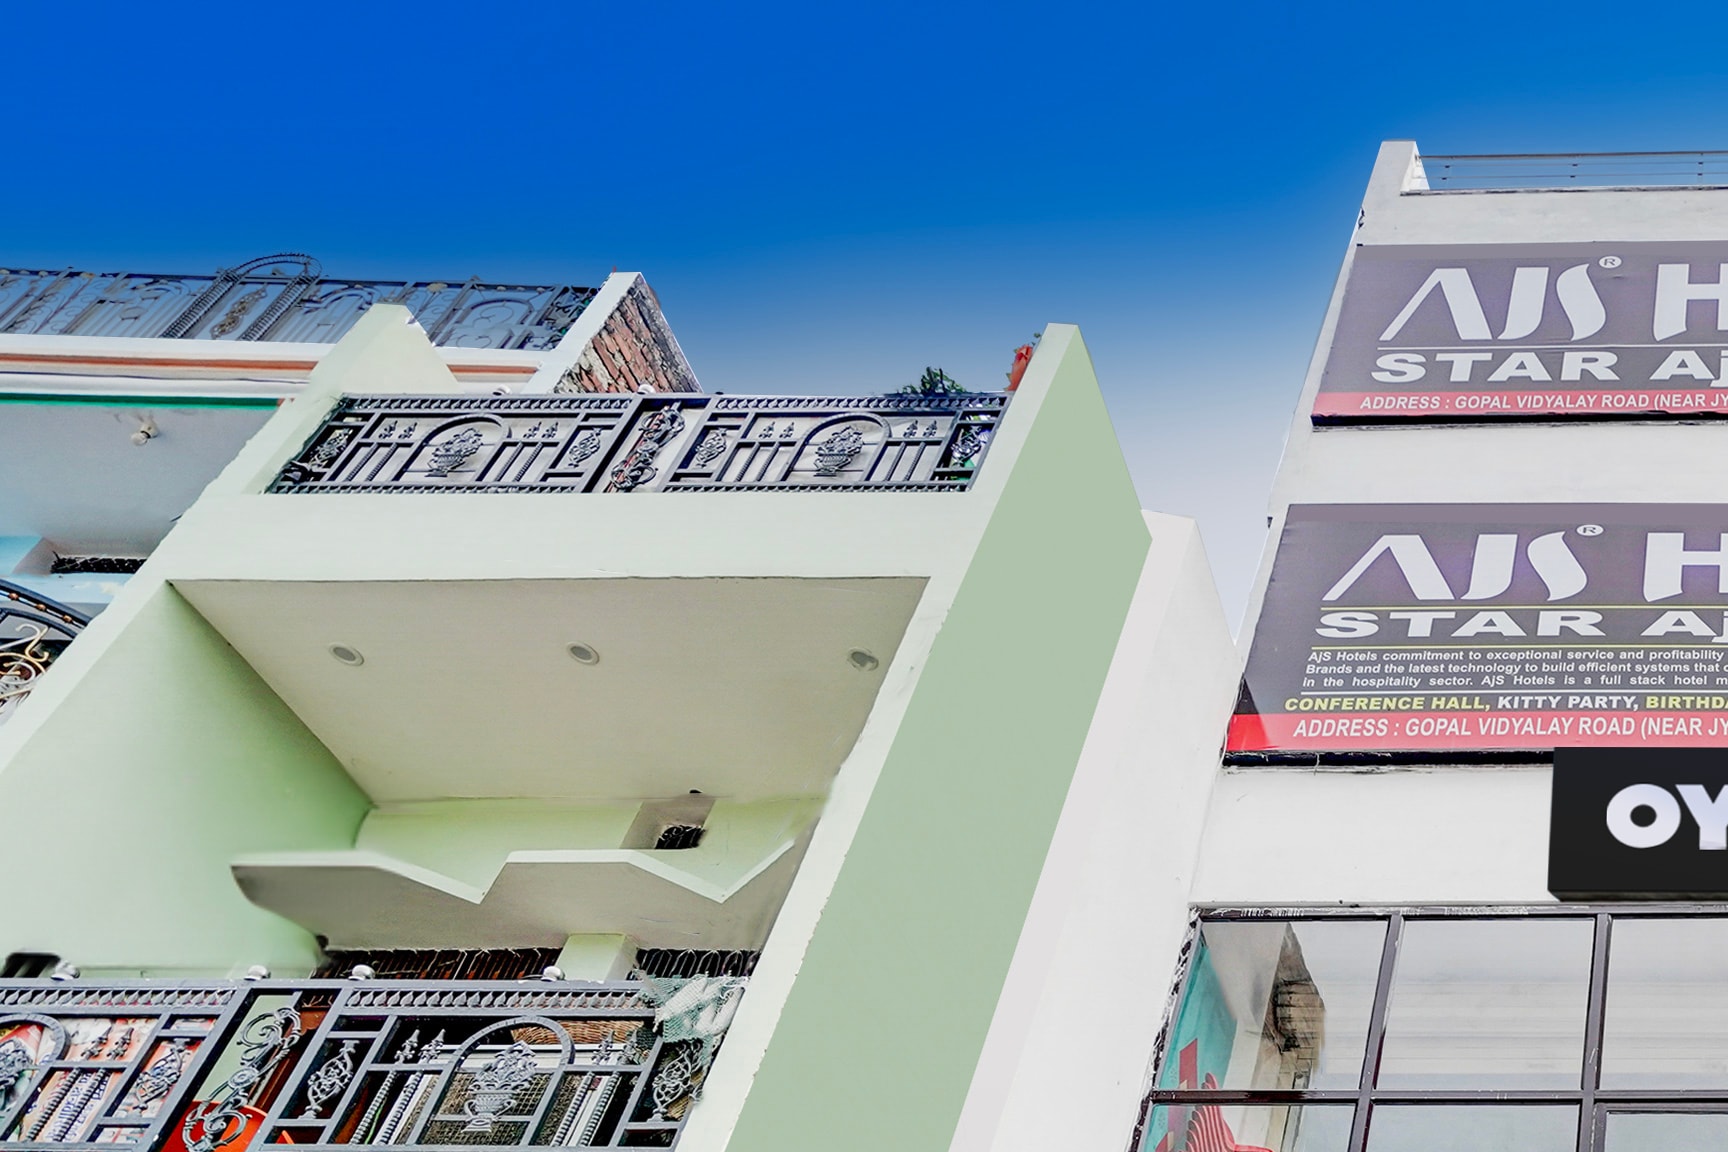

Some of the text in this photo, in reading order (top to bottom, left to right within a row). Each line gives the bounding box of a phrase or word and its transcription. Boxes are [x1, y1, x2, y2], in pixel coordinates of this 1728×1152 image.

[1370, 350, 1619, 383] STAR
[1360, 395, 1440, 410] ADDRESS
[1455, 395, 1511, 409] GOPAL
[1515, 394, 1598, 409] VIDYALAY
[1601, 393, 1649, 408] ROAD
[1654, 393, 1706, 411] (NEAR
[1314, 611, 1605, 641] STAR
[1308, 651, 1332, 663] AjS
[1336, 651, 1377, 661] Hotels
[1382, 650, 1464, 661] commitment
[1468, 651, 1482, 660] to
[1486, 650, 1562, 663] exceptional
[1567, 650, 1615, 660] service
[1619, 650, 1644, 660] and
[1649, 650, 1724, 662] profitability
[1305, 664, 1352, 674] Brands
[1356, 664, 1380, 674] and
[1384, 663, 1405, 673] the
[1408, 663, 1445, 673] latest
[1448, 663, 1520, 675] technology
[1525, 663, 1538, 672] to
[1542, 663, 1575, 672] build
[1578, 662, 1631, 672] efficient
[1635, 663, 1689, 674] systems
[1693, 663, 1720, 672] that
[1302, 677, 1315, 687] in
[1323, 676, 1344, 687] the
[1352, 676, 1421, 688] hospitality
[1429, 676, 1473, 686] sector.
[1481, 675, 1505, 687] AjS
[1513, 675, 1555, 685] Hotels
[1564, 675, 1575, 685] is
[1583, 677, 1592, 685] a
[1600, 675, 1621, 685] full
[1629, 675, 1665, 685] stack
[1674, 675, 1707, 685] hotel
[1284, 696, 1424, 711] CONFERENCE
[1431, 696, 1491, 712] HALL,
[1497, 696, 1562, 709] KITTY
[1567, 696, 1638, 711] PARTY,
[1293, 719, 1388, 737] ADDRESS
[1405, 718, 1471, 736] GOPAL
[1478, 717, 1574, 736] VIDYALAY
[1578, 717, 1635, 736] ROAD
[1641, 717, 1702, 740] (NEAR
